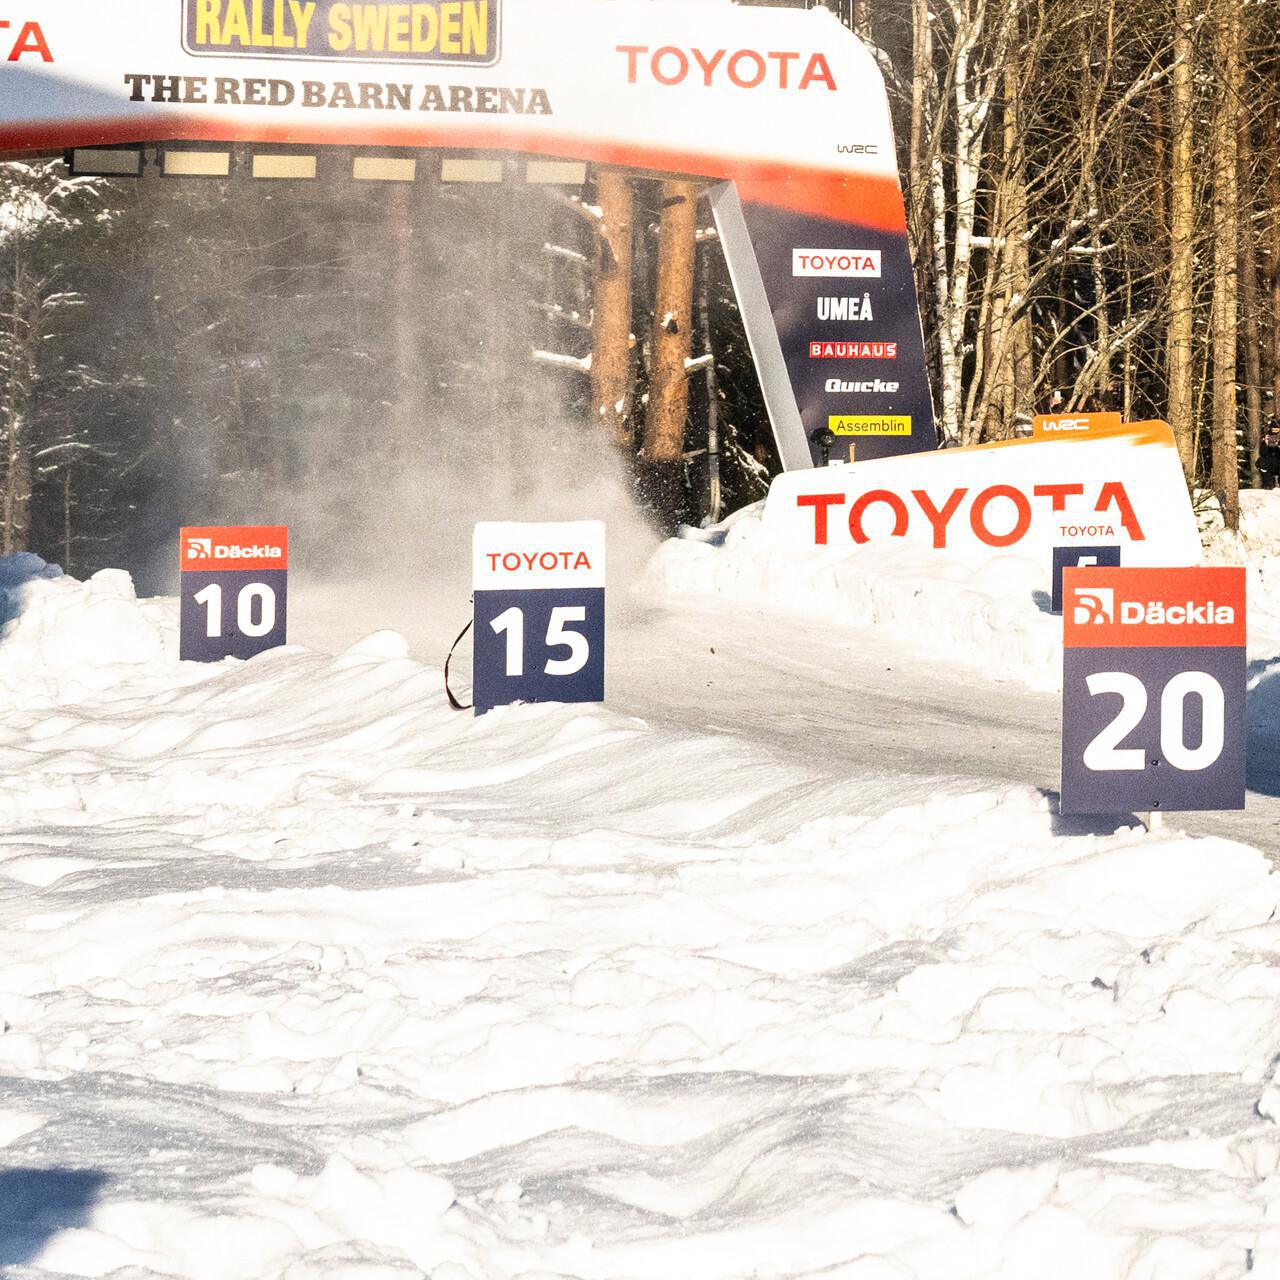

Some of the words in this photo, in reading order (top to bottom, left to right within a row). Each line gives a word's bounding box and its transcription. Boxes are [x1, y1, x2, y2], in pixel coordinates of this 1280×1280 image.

[327, 0, 489, 56] SWEDEN
[615, 45, 838, 91] TOYOTA
[124, 74, 207, 103] THE
[214, 77, 295, 106] RED
[301, 80, 413, 111] BARN
[420, 83, 553, 115] ARENA
[837, 144, 878, 155] WRC
[798, 255, 876, 271] TOYOTA
[817, 293, 873, 321] UMEÅ
[811, 343, 896, 358] BAUHAUS
[825, 379, 899, 394] Quicke
[836, 419, 905, 433] Assemblin
[1043, 419, 1090, 431] WRC
[796, 482, 1145, 548] TOYOTA
[1060, 525, 1114, 536] TOYOTA
[215, 542, 282, 560] Däckia
[486, 551, 592, 571] TOYOTA
[193, 582, 276, 638] 10
[1121, 600, 1235, 625] Däckia
[489, 605, 590, 677] 15
[1083, 671, 1225, 771] 20
